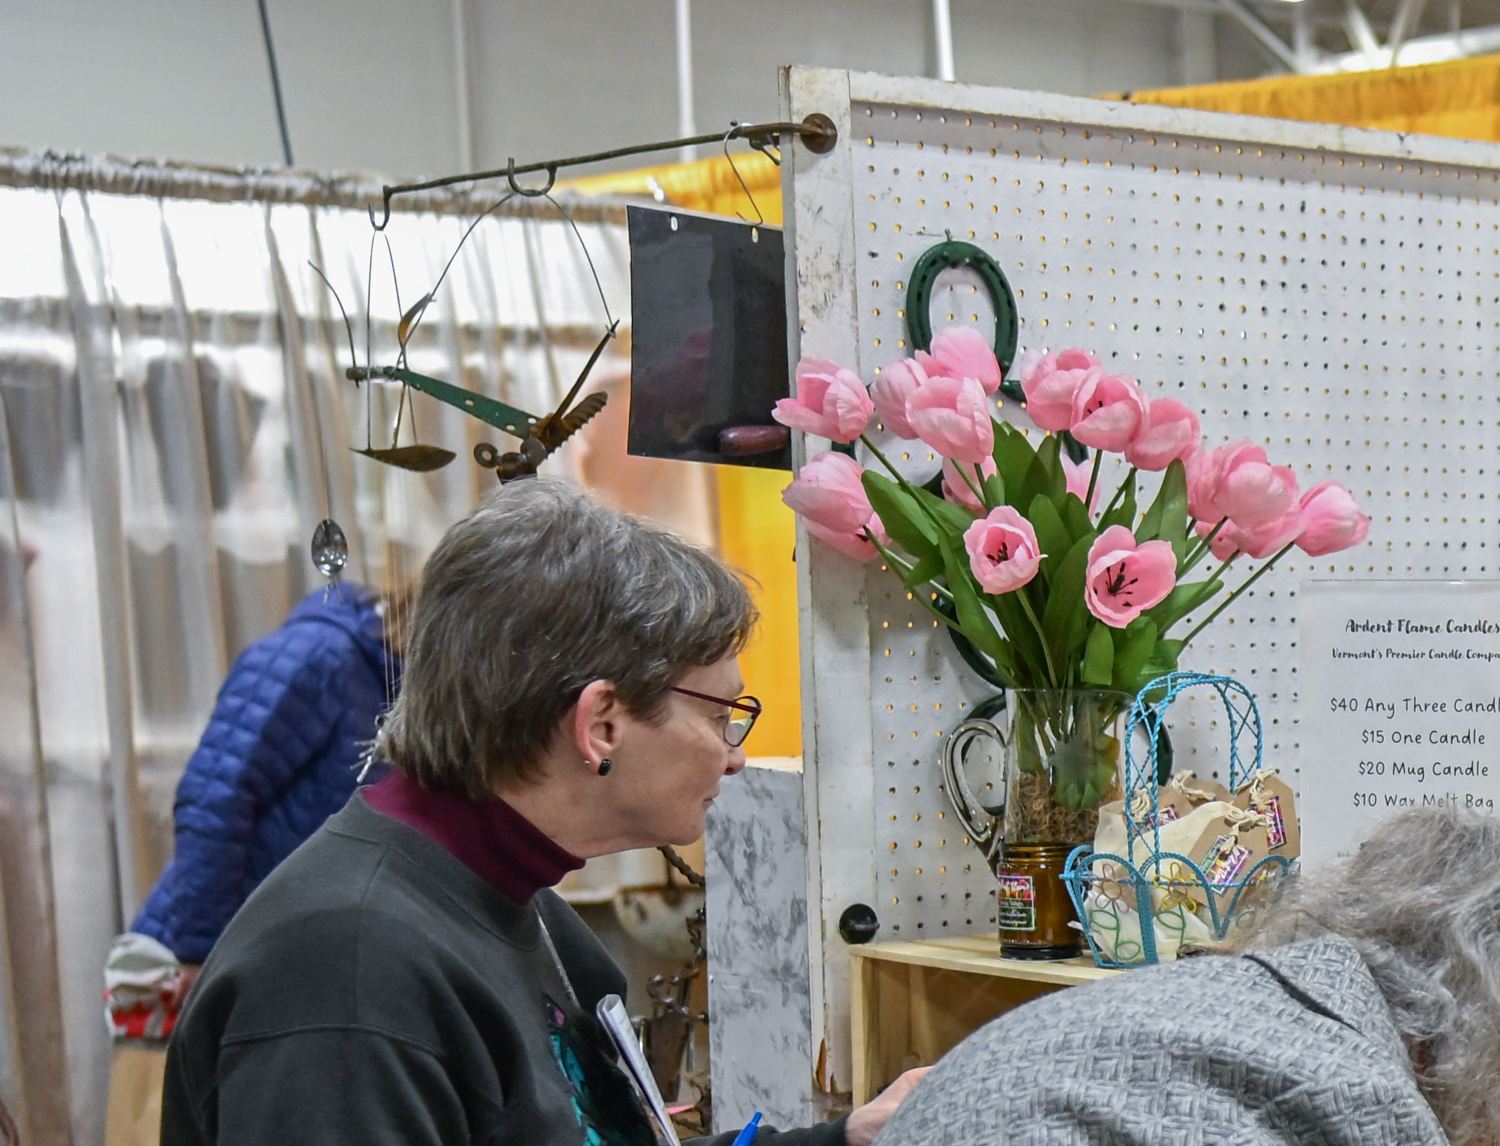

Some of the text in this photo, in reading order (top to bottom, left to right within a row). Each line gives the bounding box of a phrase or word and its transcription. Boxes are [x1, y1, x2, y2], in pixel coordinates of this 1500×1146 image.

[1346, 618, 1500, 634] Ardent Flame Candles
[1332, 648, 1383, 660] Vermont's
[1386, 648, 1426, 660] Premier
[1429, 649, 1463, 660] Candle
[1330, 697, 1358, 713] $40
[1365, 698, 1395, 719] Any
[1402, 697, 1447, 713] Three
[1362, 729, 1485, 745] $15 One Candle
[1359, 761, 1489, 782] $20 Mug Candle
[1353, 793, 1377, 807] $10
[1384, 794, 1415, 808] Wax
[1465, 794, 1494, 813] Bag
